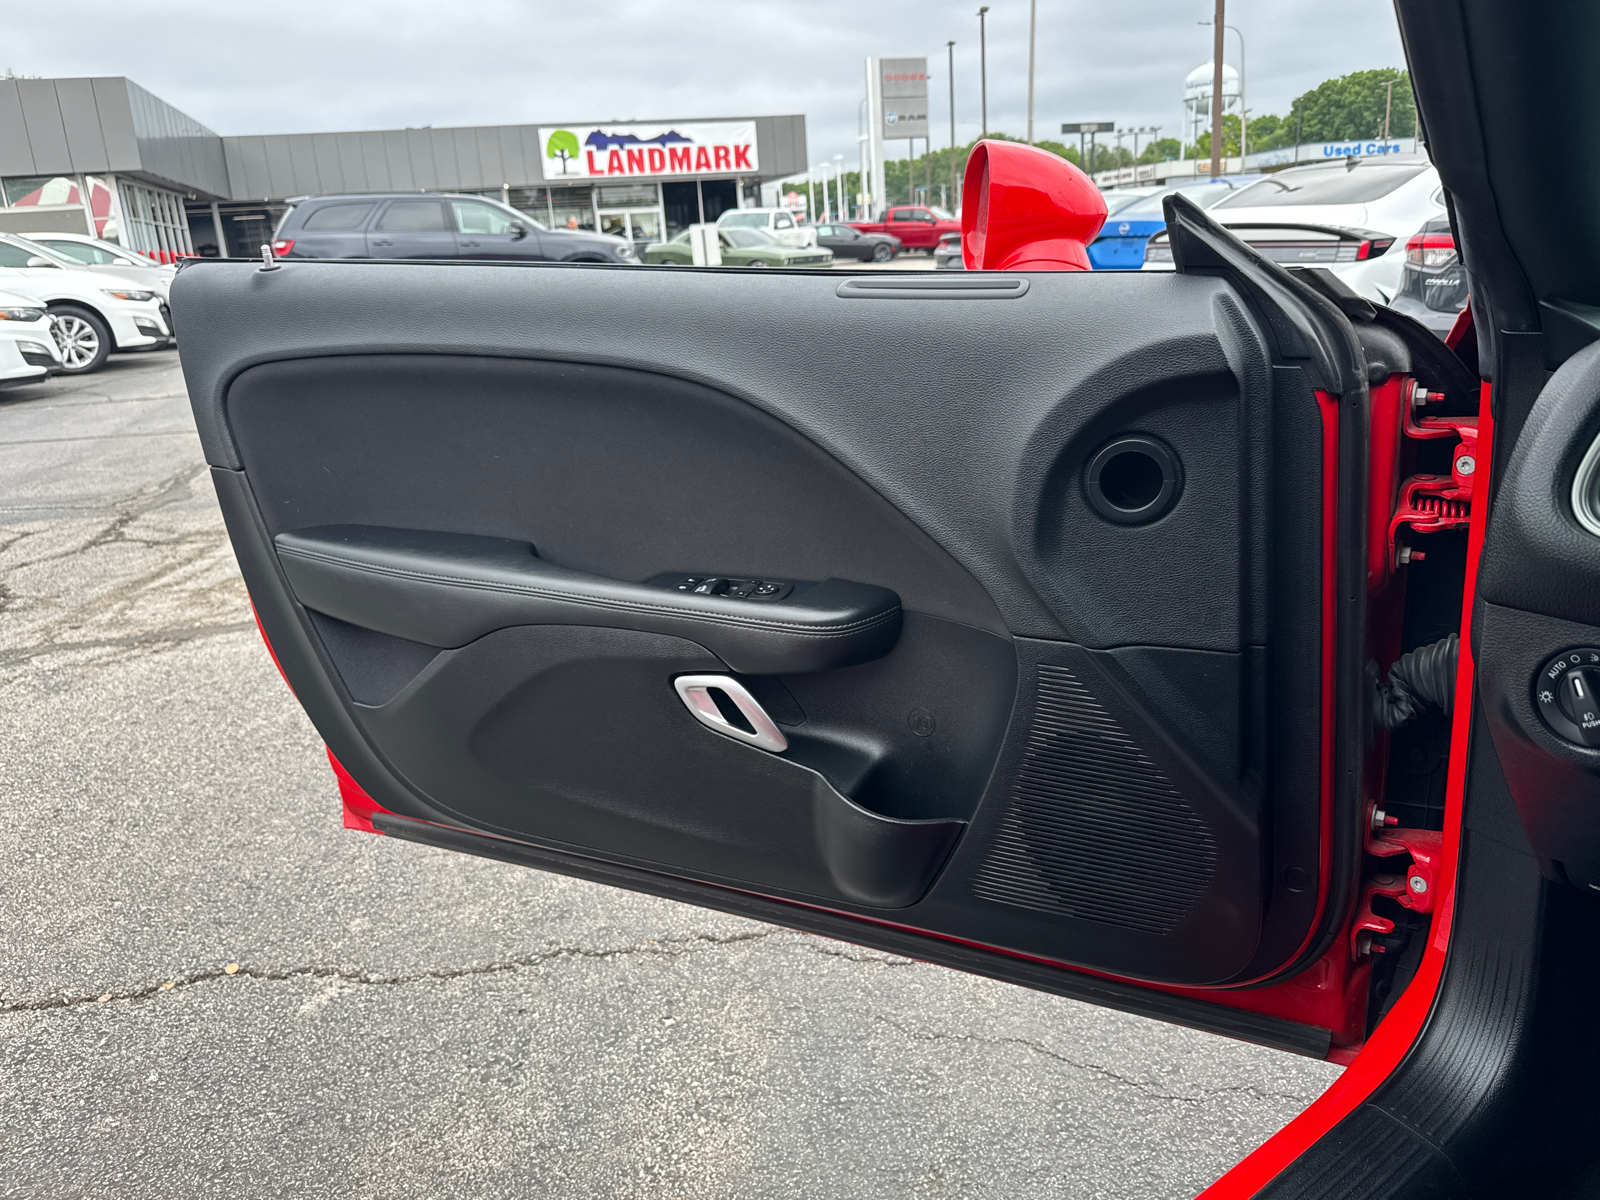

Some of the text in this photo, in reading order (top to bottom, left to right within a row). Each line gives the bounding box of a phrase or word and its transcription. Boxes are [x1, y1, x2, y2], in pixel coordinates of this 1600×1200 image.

[1323, 143, 1400, 158] Used Cars
[586, 144, 752, 176] LANDMARK
[1425, 278, 1460, 286] COROLLA
[1548, 661, 1566, 680] AUTO
[1581, 719, 1600, 729] PUSH
